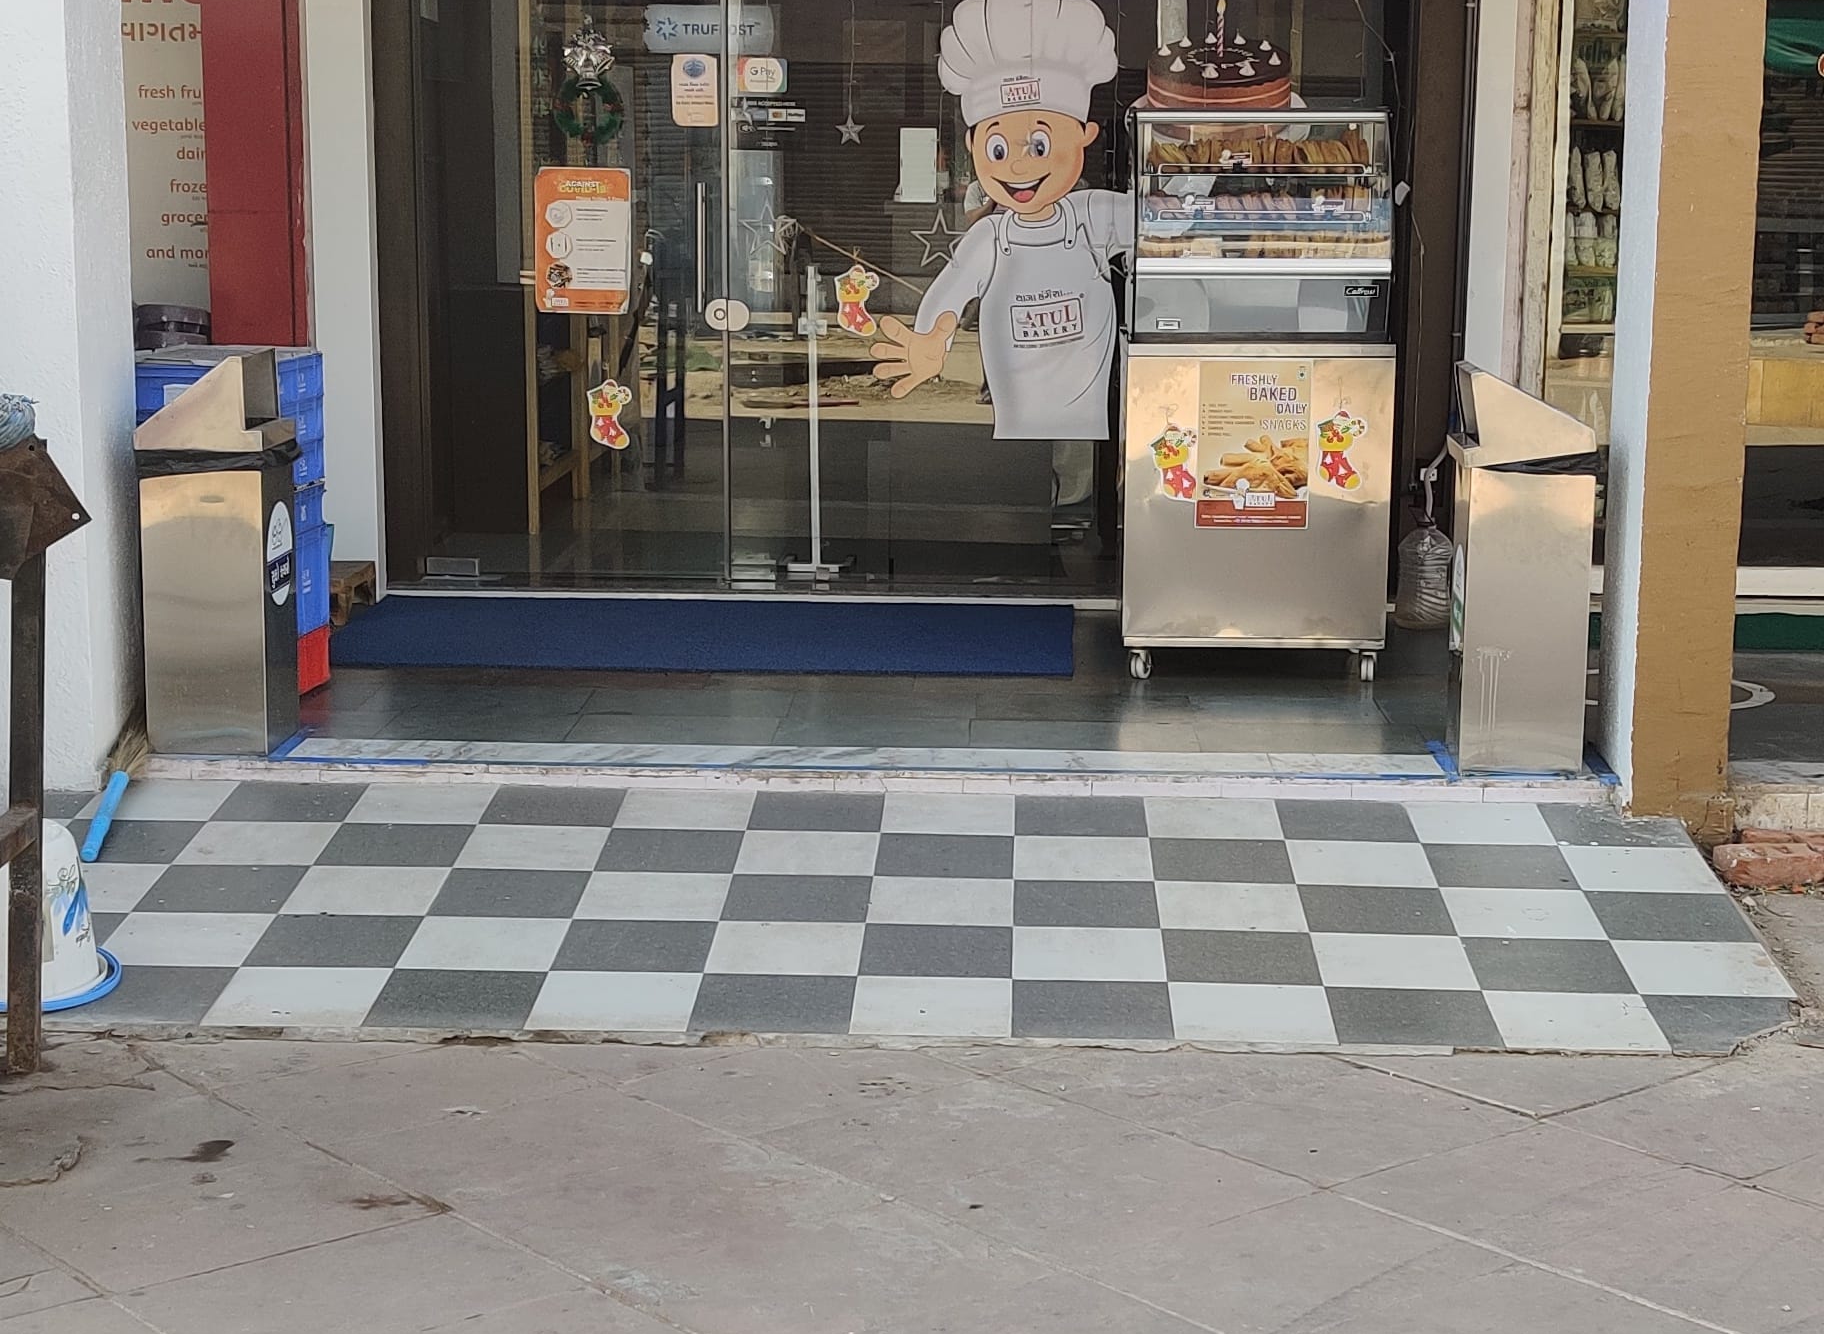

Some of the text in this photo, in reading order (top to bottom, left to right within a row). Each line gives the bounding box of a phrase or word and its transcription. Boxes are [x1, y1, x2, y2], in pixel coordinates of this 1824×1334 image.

[138, 85, 176, 99] fresh
[146, 245, 175, 259] and
[1023, 305, 1078, 329] ATUL
[1023, 323, 1078, 338] BAKERY
[1231, 374, 1278, 386] FRESHLY
[1249, 387, 1298, 402] BAKED
[1276, 402, 1308, 415] DAILY
[1261, 419, 1307, 431] SNACKS
